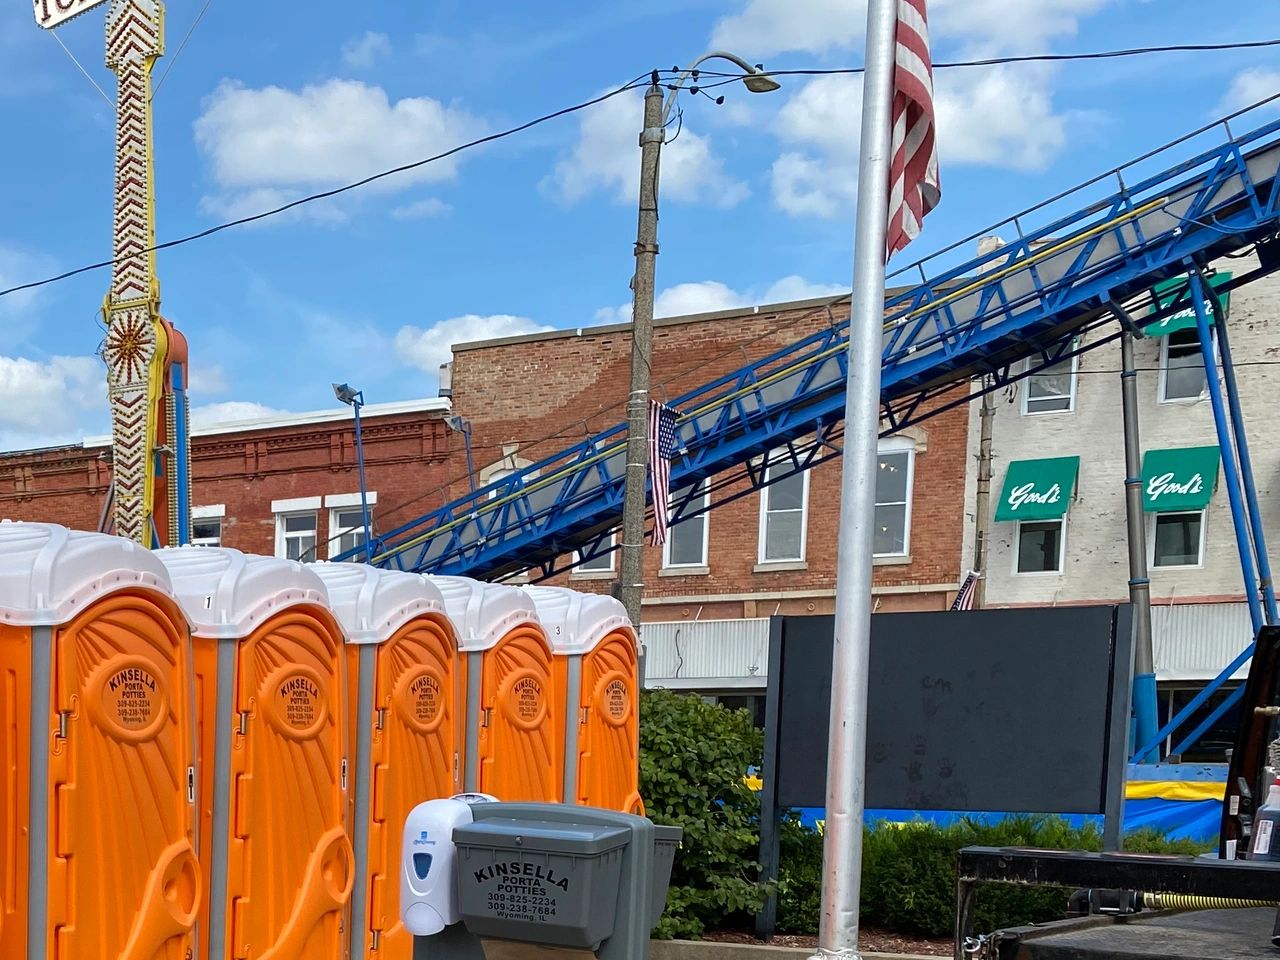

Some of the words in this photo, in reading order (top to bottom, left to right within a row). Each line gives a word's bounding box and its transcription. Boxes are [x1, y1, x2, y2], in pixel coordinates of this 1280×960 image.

[1147, 473, 1203, 500] Good's
[1008, 483, 1061, 510] Good's
[206, 596, 211, 609] 1
[109, 669, 155, 692] KINSELLA
[411, 677, 439, 694] KINSELLA
[514, 679, 540, 694] KINSELLA
[281, 679, 317, 699] KINSELLA
[474, 862, 569, 891] KINSELLA
[503, 876, 541, 886] PORTA
[497, 884, 546, 896] POTTIES
[488, 893, 556, 906] 309-825-2234
[488, 902, 556, 915] 309-238-7684
[497, 911, 536, 921] Wyoming,
